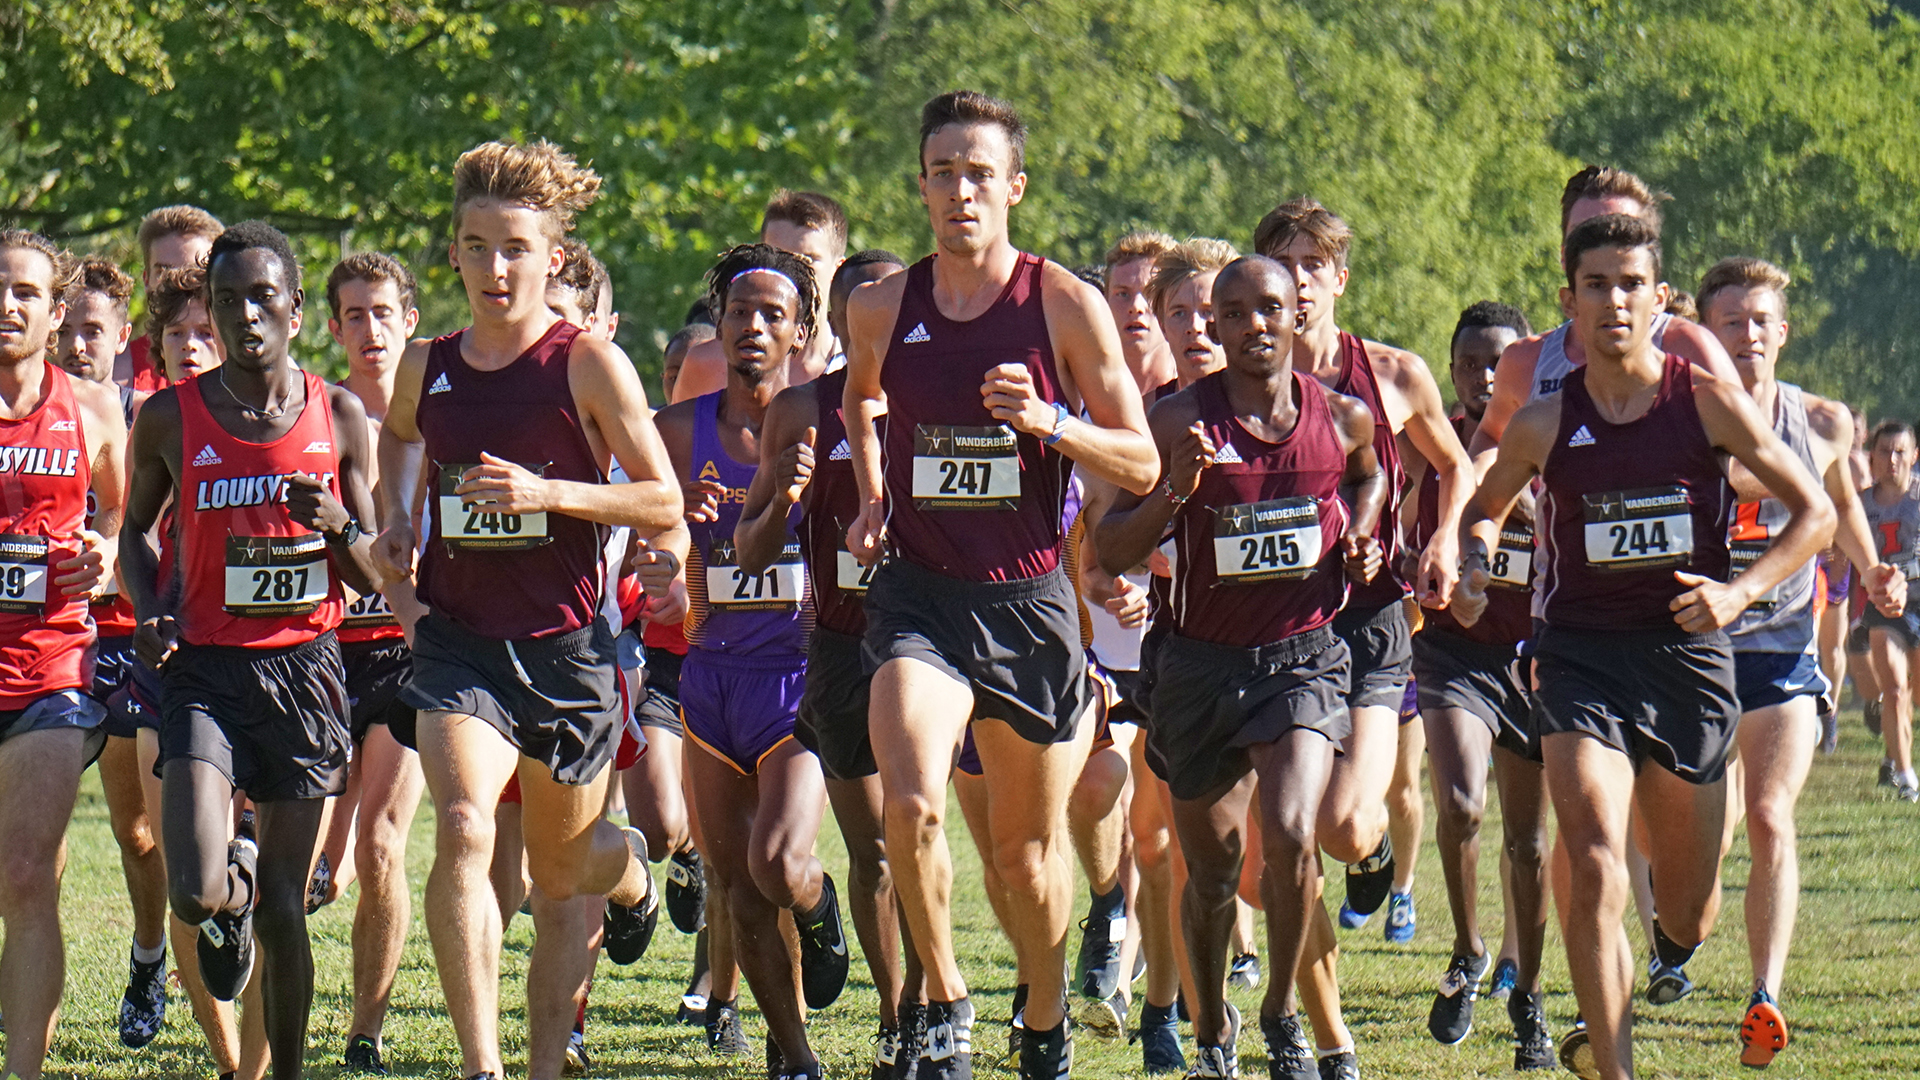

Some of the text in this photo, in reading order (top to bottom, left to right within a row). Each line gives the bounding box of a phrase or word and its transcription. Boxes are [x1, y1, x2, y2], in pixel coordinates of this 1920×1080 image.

[903, 334, 931, 344] adidas
[429, 384, 452, 395] adidas
[1539, 379, 1563, 395] BI
[49, 421, 76, 431] ACC
[303, 442, 331, 453] ACC
[955, 435, 1014, 447] VANDERBILT
[1568, 437, 1596, 448] adidas
[0, 446, 80, 477] SVILLE
[192, 457, 223, 467] adidas
[828, 452, 852, 461] adida
[939, 461, 992, 495] 247
[1624, 494, 1687, 510] VANDERBILT
[1255, 504, 1317, 522] VANDERBILT
[1609, 520, 1670, 557] 244
[0, 541, 47, 555] NDERBILT
[271, 539, 326, 556] VANDERBILT
[1240, 532, 1300, 571] 245
[252, 567, 309, 602] 287
